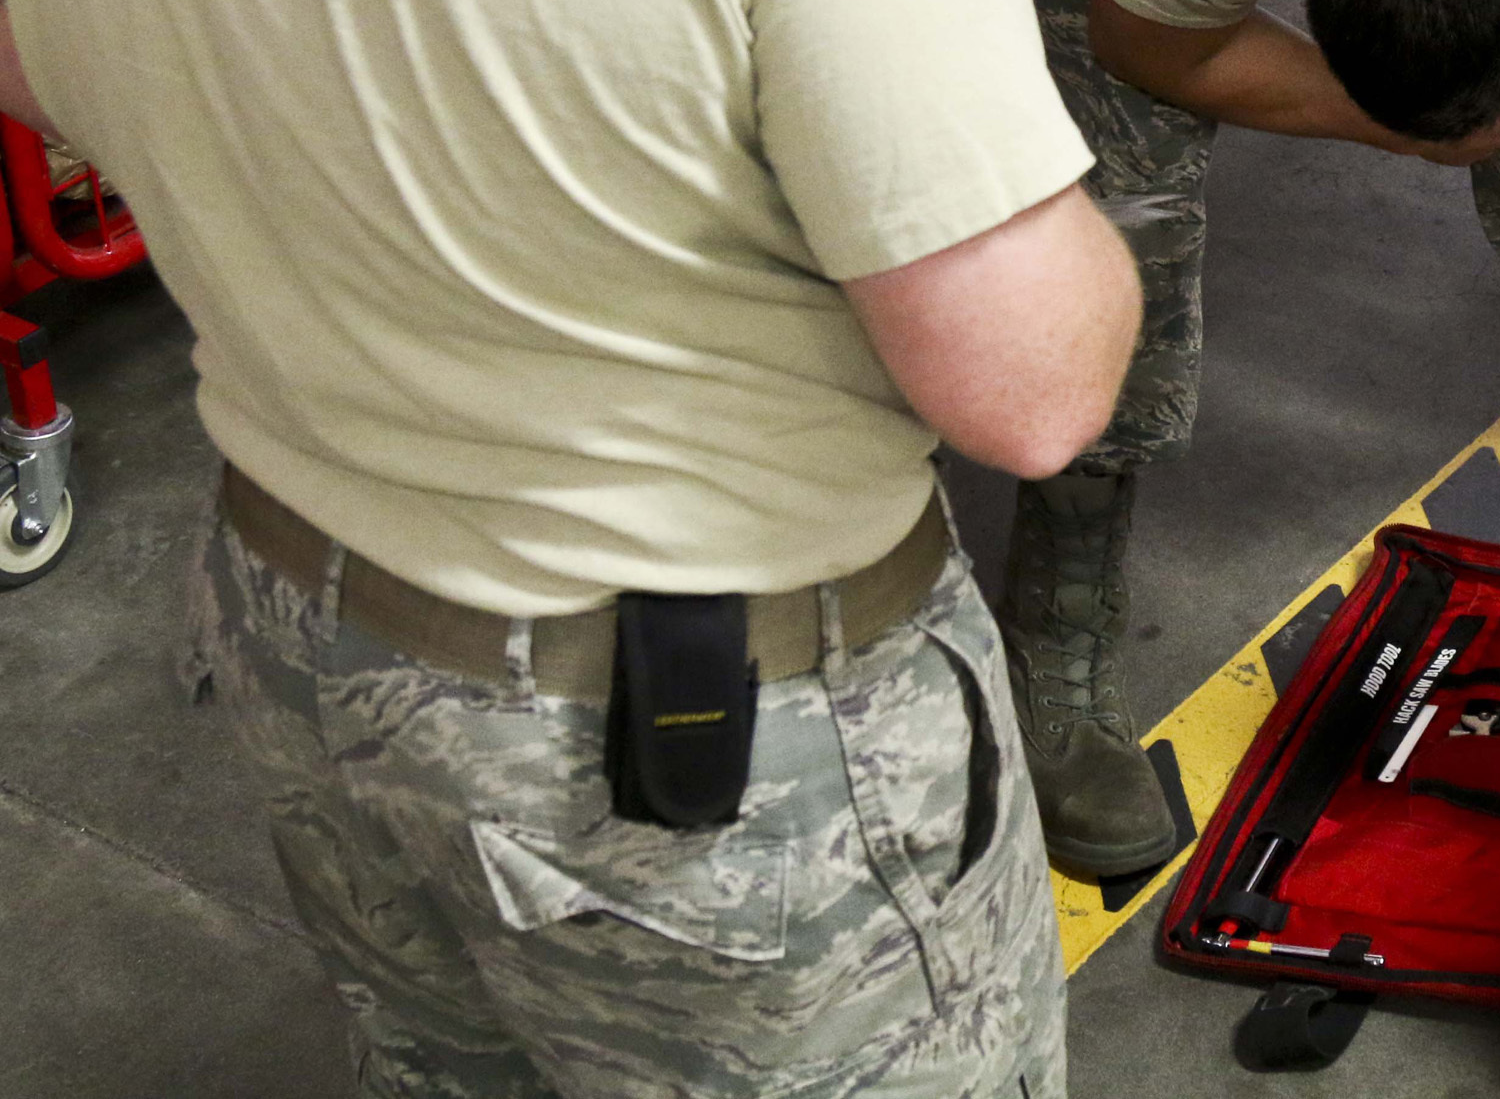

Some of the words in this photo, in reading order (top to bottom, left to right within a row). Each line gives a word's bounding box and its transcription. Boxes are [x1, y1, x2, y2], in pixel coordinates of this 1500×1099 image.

[1360, 665, 1388, 699] HOOD
[1376, 643, 1402, 670] TOOL
[1393, 699, 1421, 724] HACK
[1409, 679, 1433, 699] SAW
[1424, 648, 1457, 677] BLADES
